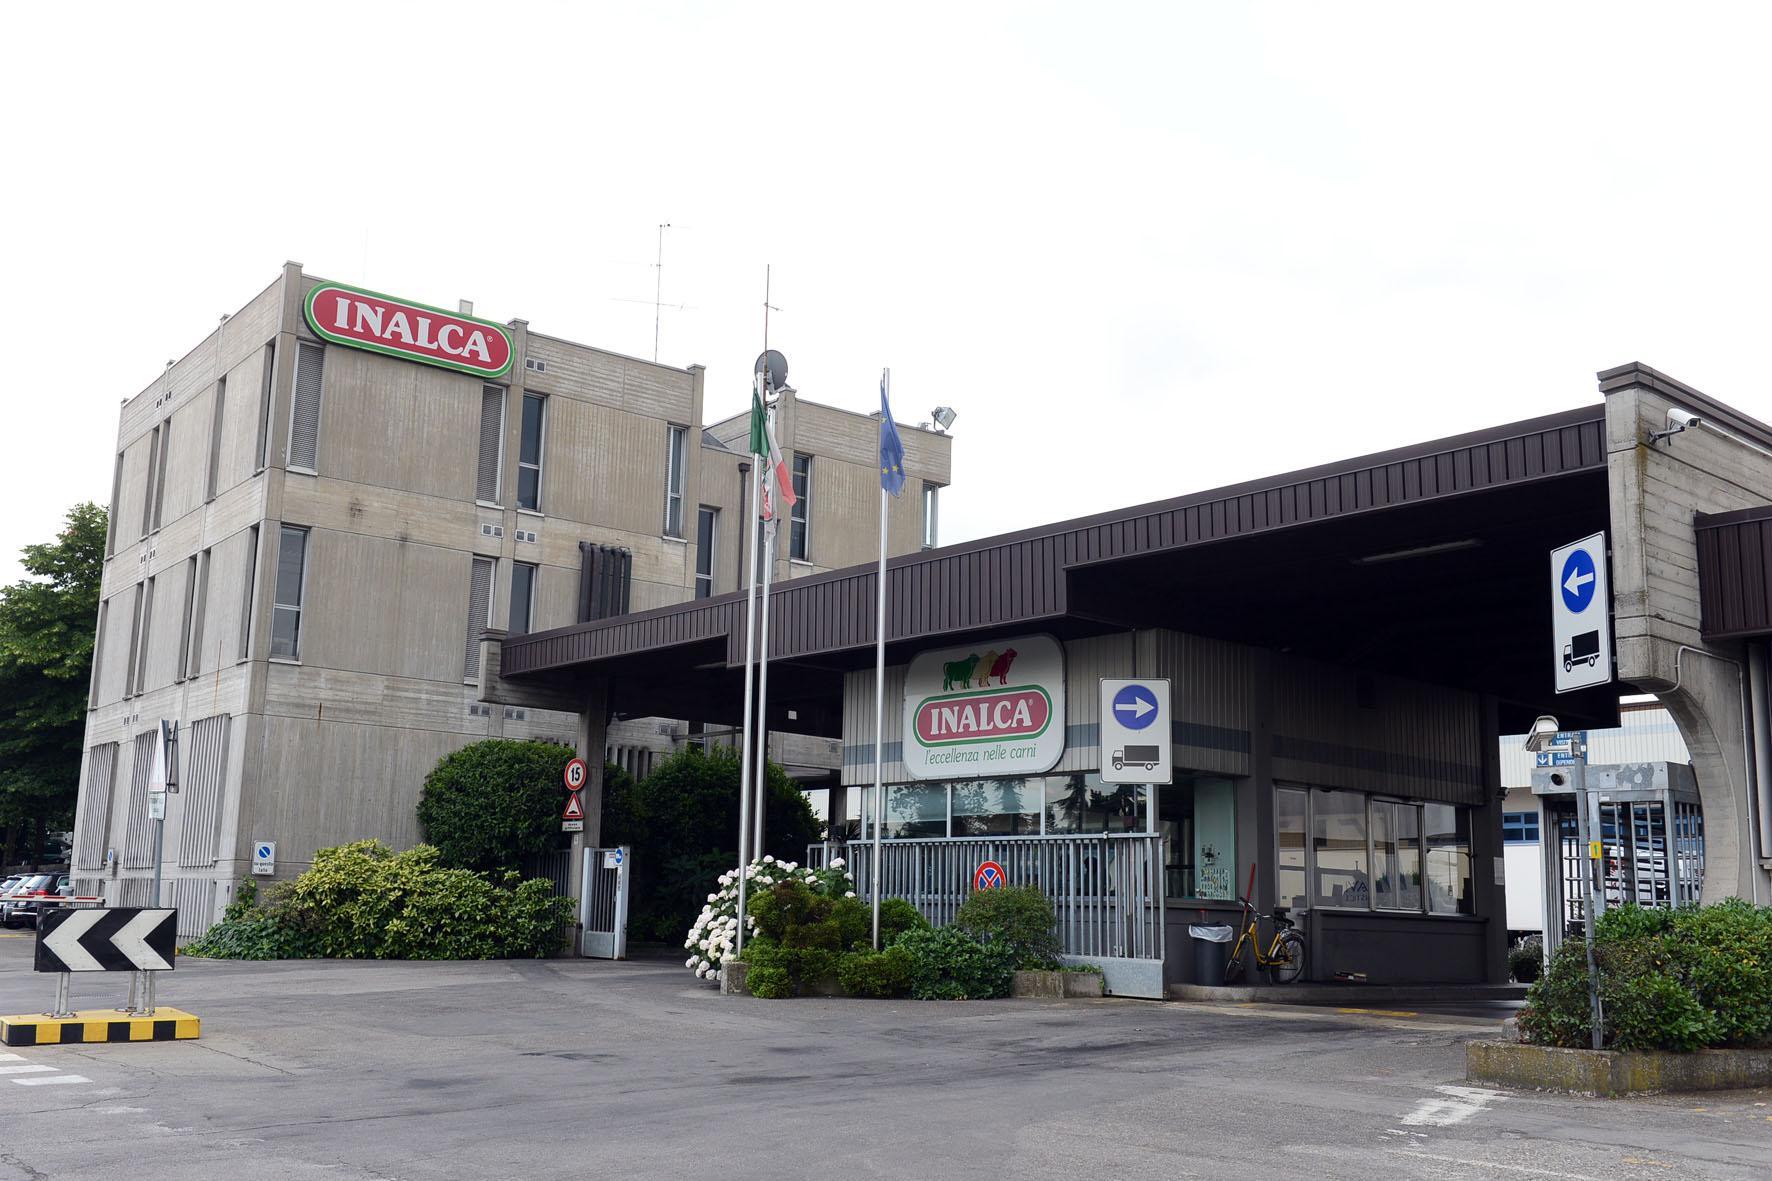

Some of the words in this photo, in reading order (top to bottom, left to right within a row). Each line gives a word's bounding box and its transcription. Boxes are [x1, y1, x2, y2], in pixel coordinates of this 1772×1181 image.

[334, 297, 492, 363] INALCA
[930, 698, 1033, 735] INALCA
[924, 747, 979, 765] l'eccellenza
[983, 744, 1007, 760] nelle
[1010, 743, 1037, 759] carni
[571, 766, 581, 782] 15
